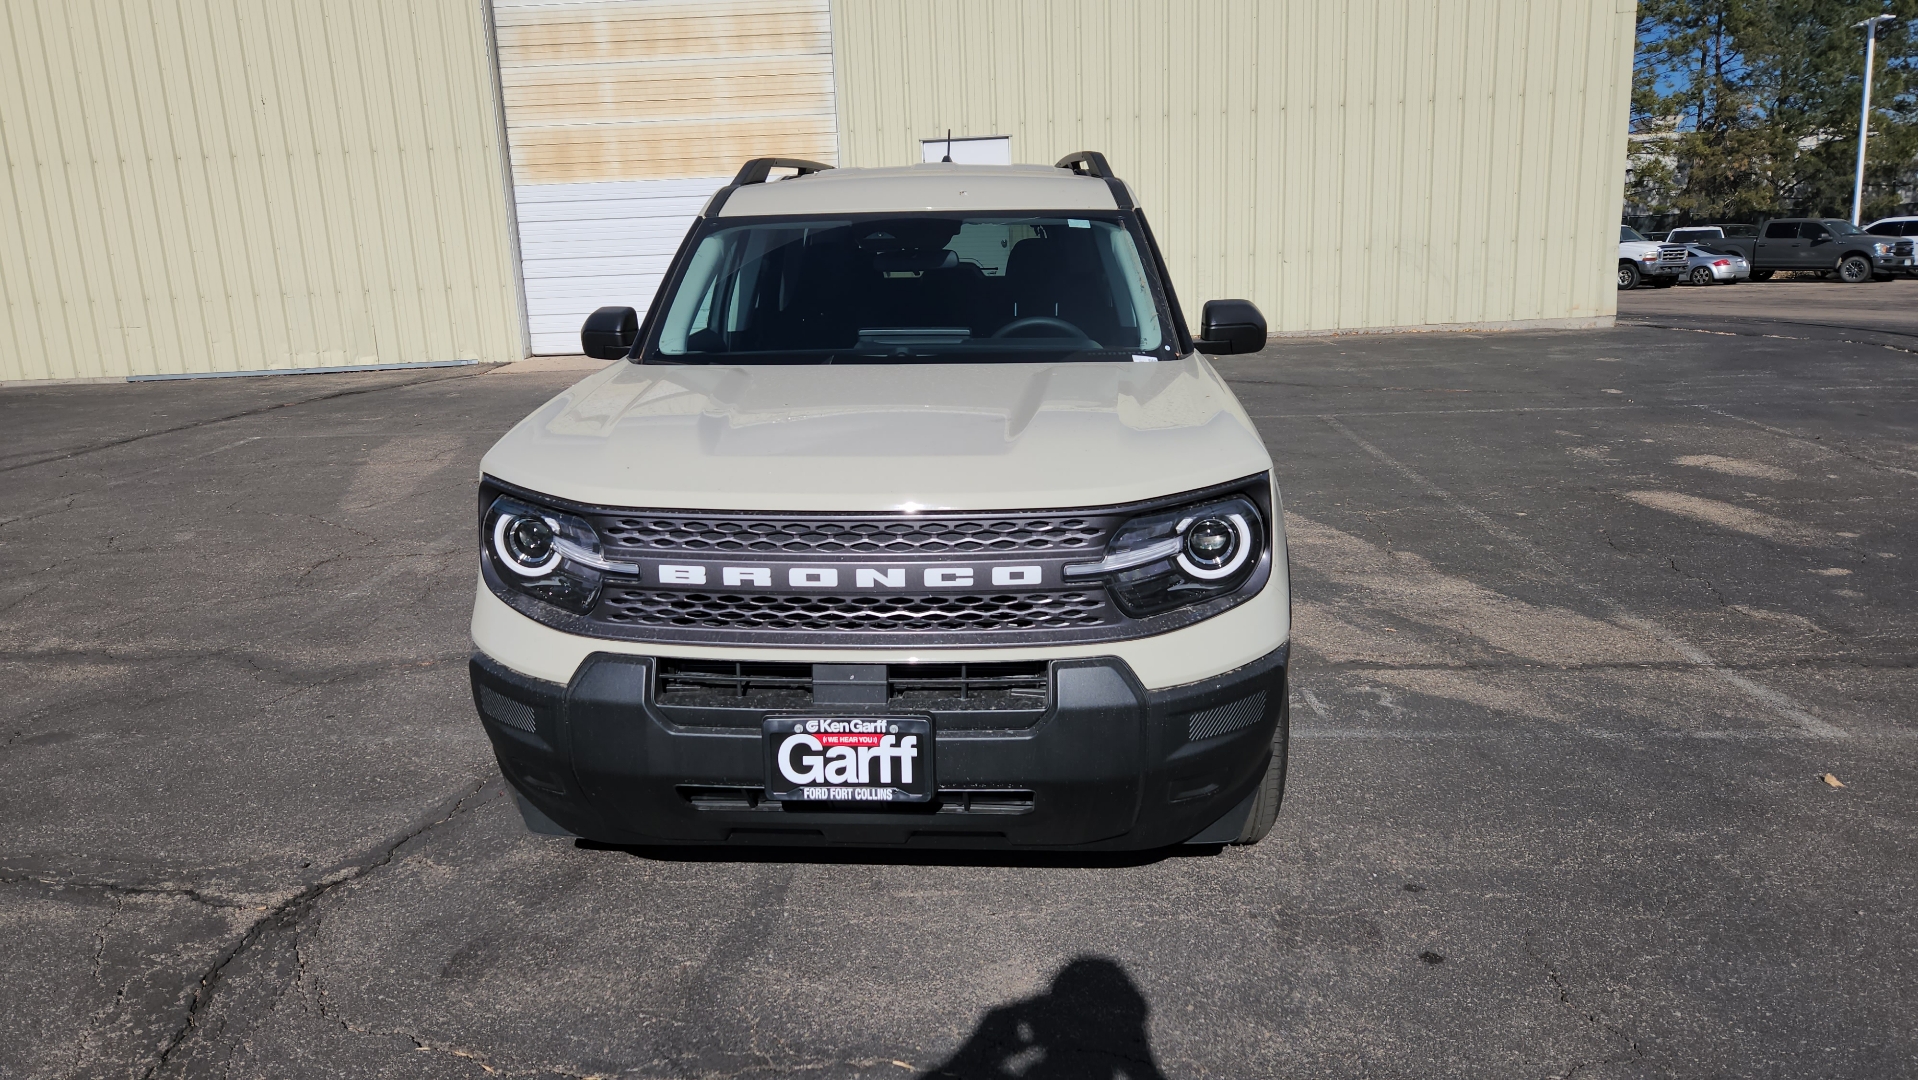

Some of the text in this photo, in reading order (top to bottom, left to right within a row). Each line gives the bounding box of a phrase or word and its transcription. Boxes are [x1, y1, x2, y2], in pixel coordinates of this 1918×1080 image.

[658, 564, 1042, 588] BRONCO
[820, 719, 850, 733] Ken
[850, 719, 888, 733] Garff
[777, 733, 918, 785] Garff
[803, 788, 893, 801] FORD FORT COLLINS
